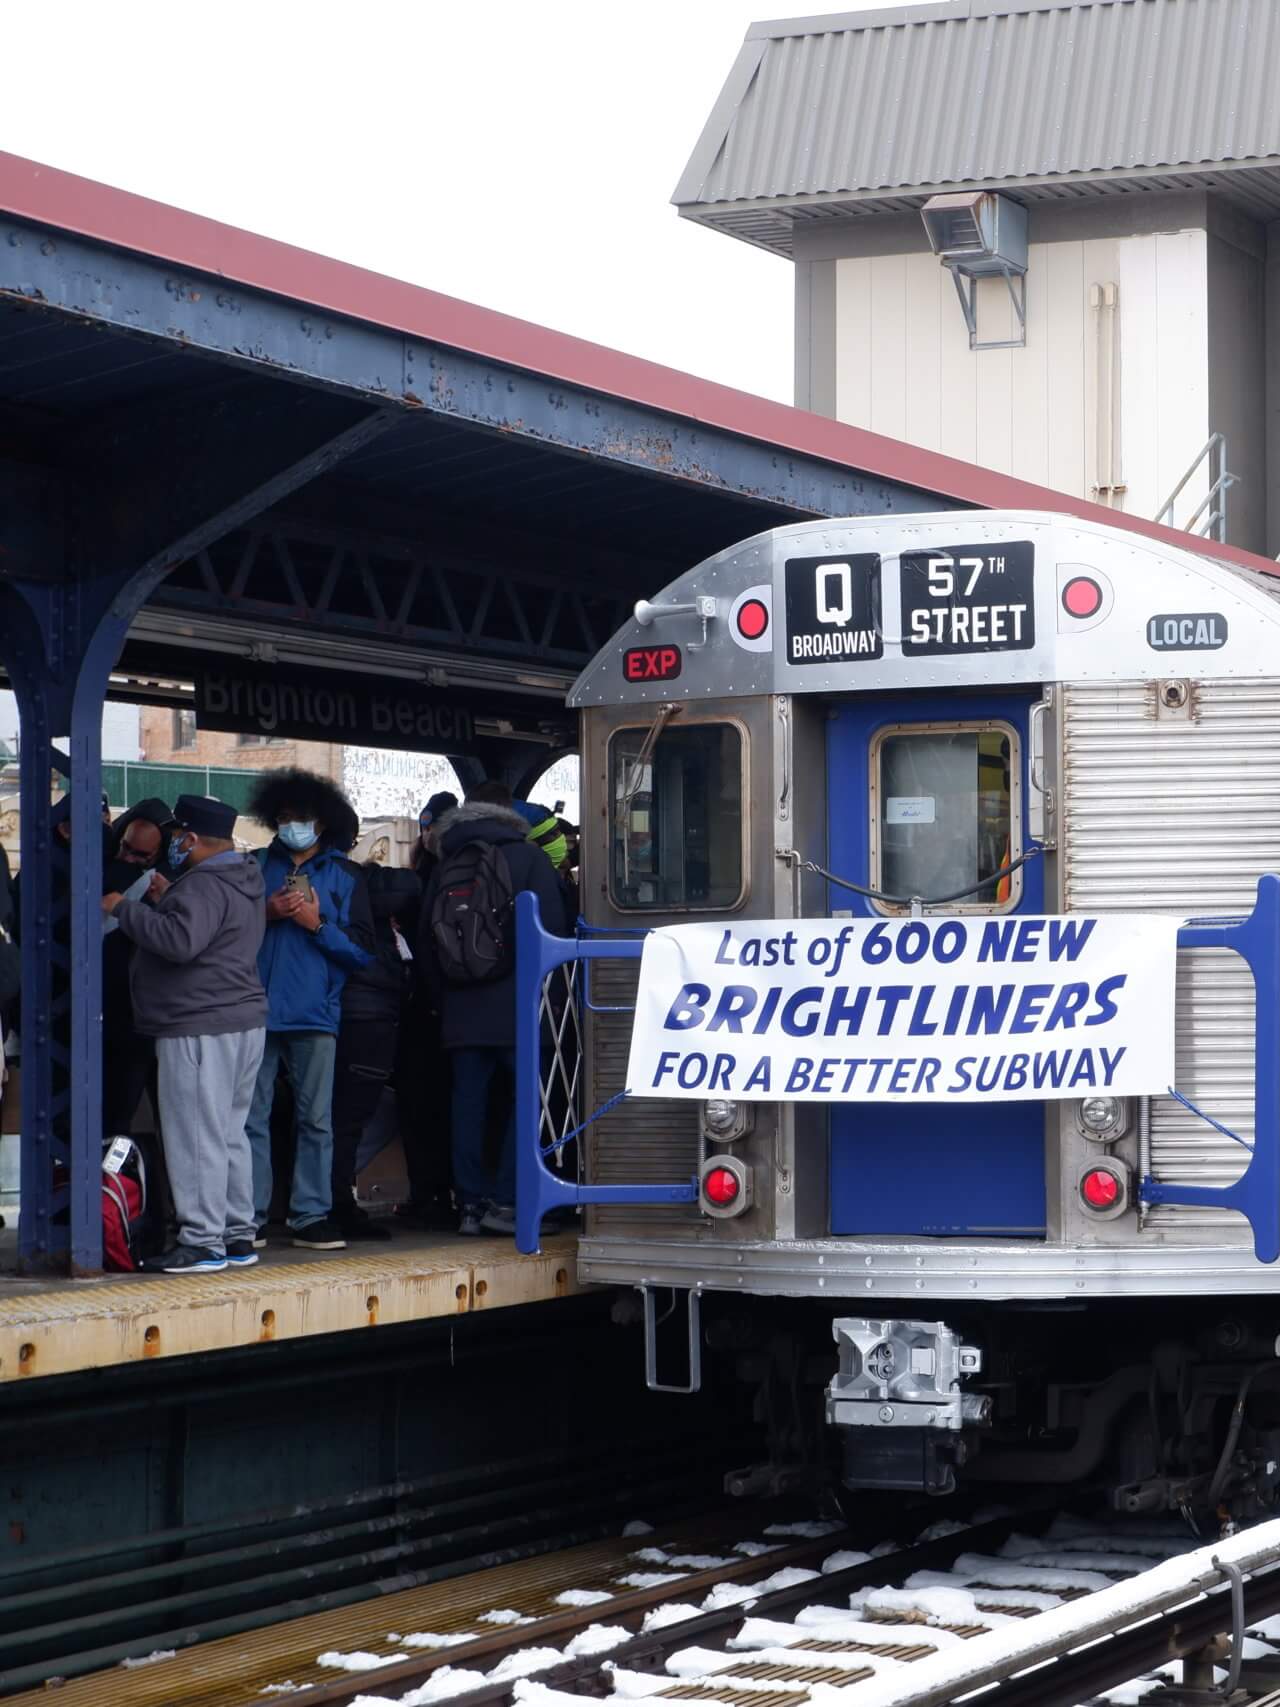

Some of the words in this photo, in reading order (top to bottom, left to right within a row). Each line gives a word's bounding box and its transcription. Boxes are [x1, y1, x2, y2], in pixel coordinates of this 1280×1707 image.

[816, 562, 853, 627] Q
[792, 630, 877, 658] BROADWAY
[907, 604, 1027, 644] STREET
[1150, 618, 1223, 646] LOCAL
[628, 650, 677, 678] EXP
[715, 930, 798, 967] Last
[808, 926, 855, 977] of
[861, 920, 967, 966] 600
[977, 919, 1097, 963] NEW
[664, 974, 1127, 1037] BRIGHTLINERS
[651, 1051, 737, 1090] FOR
[743, 1055, 771, 1091] A
[784, 1056, 942, 1093] BETTER
[947, 1046, 1127, 1092] SUBWAY
